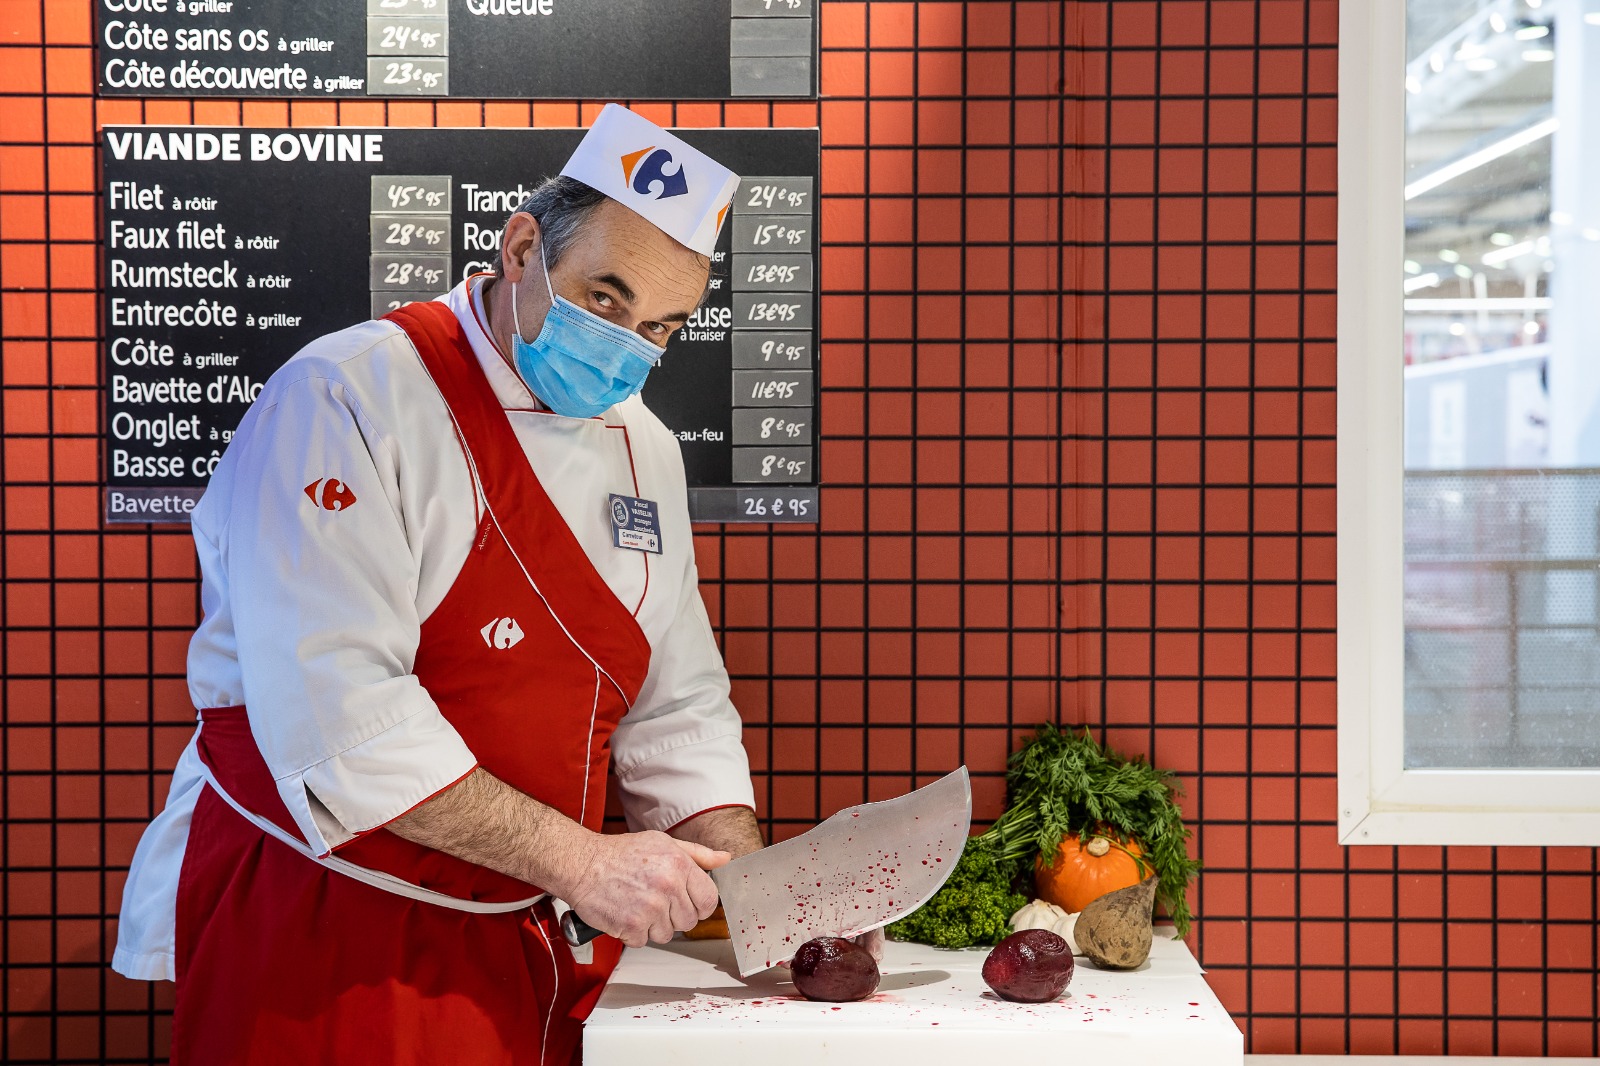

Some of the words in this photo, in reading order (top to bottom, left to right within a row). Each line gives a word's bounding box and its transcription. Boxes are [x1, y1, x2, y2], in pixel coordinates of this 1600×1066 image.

[175, 0, 186, 13] à
[188, 0, 234, 16] griller
[466, 0, 554, 17] Queue
[104, 20, 169, 51] Côte
[174, 28, 233, 52] sans
[238, 29, 270, 52] os
[277, 37, 288, 52] à
[289, 37, 335, 55] griller
[105, 58, 166, 89] Côte
[169, 59, 308, 90] découverte
[312, 75, 323, 90] à
[324, 75, 365, 93] griller
[106, 132, 242, 161] VIANDE
[250, 133, 384, 162] BOVINE
[110, 181, 165, 211] Filet
[172, 196, 182, 211] à
[185, 196, 218, 211] rôtir
[110, 220, 170, 250] Faux
[176, 220, 226, 250] filet
[234, 235, 244, 250] à
[247, 235, 280, 250] rôtir
[111, 259, 239, 289] Rumsteck
[246, 274, 256, 289] à
[259, 274, 292, 289] rôtir
[111, 297, 237, 327] Entrecôte
[245, 313, 255, 327] à
[258, 313, 302, 330] griller
[679, 328, 687, 341] à
[689, 328, 726, 342] braiser
[111, 337, 174, 367] Côte
[182, 352, 192, 366] à
[195, 352, 239, 370] griller
[112, 374, 202, 404] Bavette
[112, 411, 201, 448] Onglet
[209, 426, 219, 441] à
[113, 449, 185, 478] Basse
[110, 492, 195, 513] Bavette
